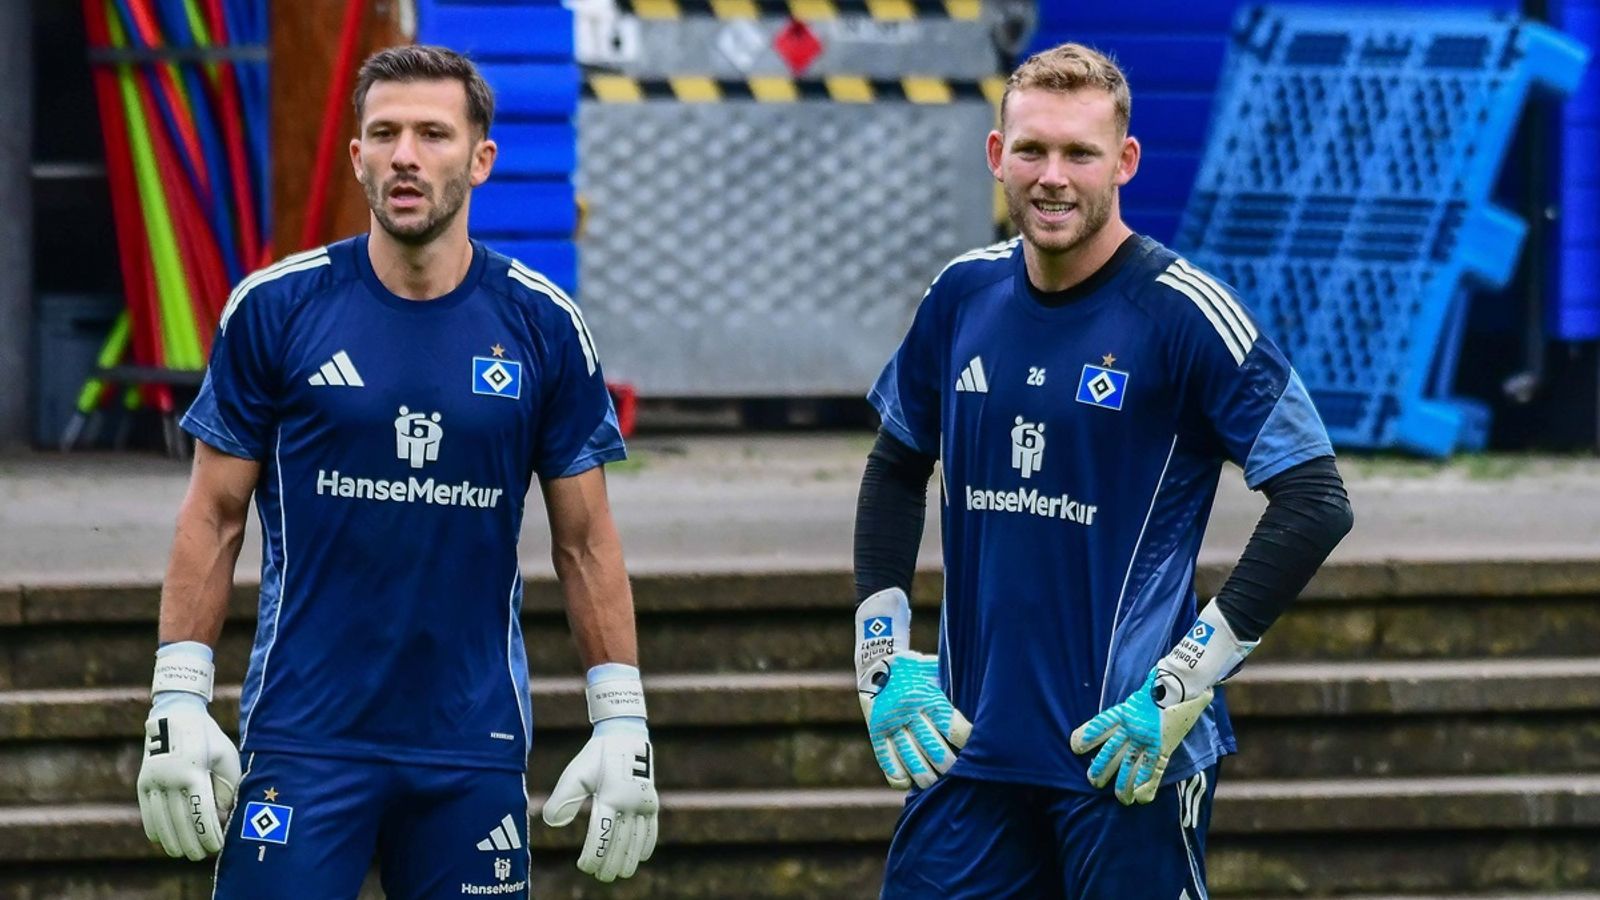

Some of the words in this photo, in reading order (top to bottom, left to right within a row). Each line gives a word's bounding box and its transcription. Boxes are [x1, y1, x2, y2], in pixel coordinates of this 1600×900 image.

[1026, 366, 1047, 387] 26
[316, 469, 503, 508] HanseMerkur
[861, 647, 894, 665] Daniel
[1173, 648, 1199, 670] Danie
[257, 845, 267, 862] 1
